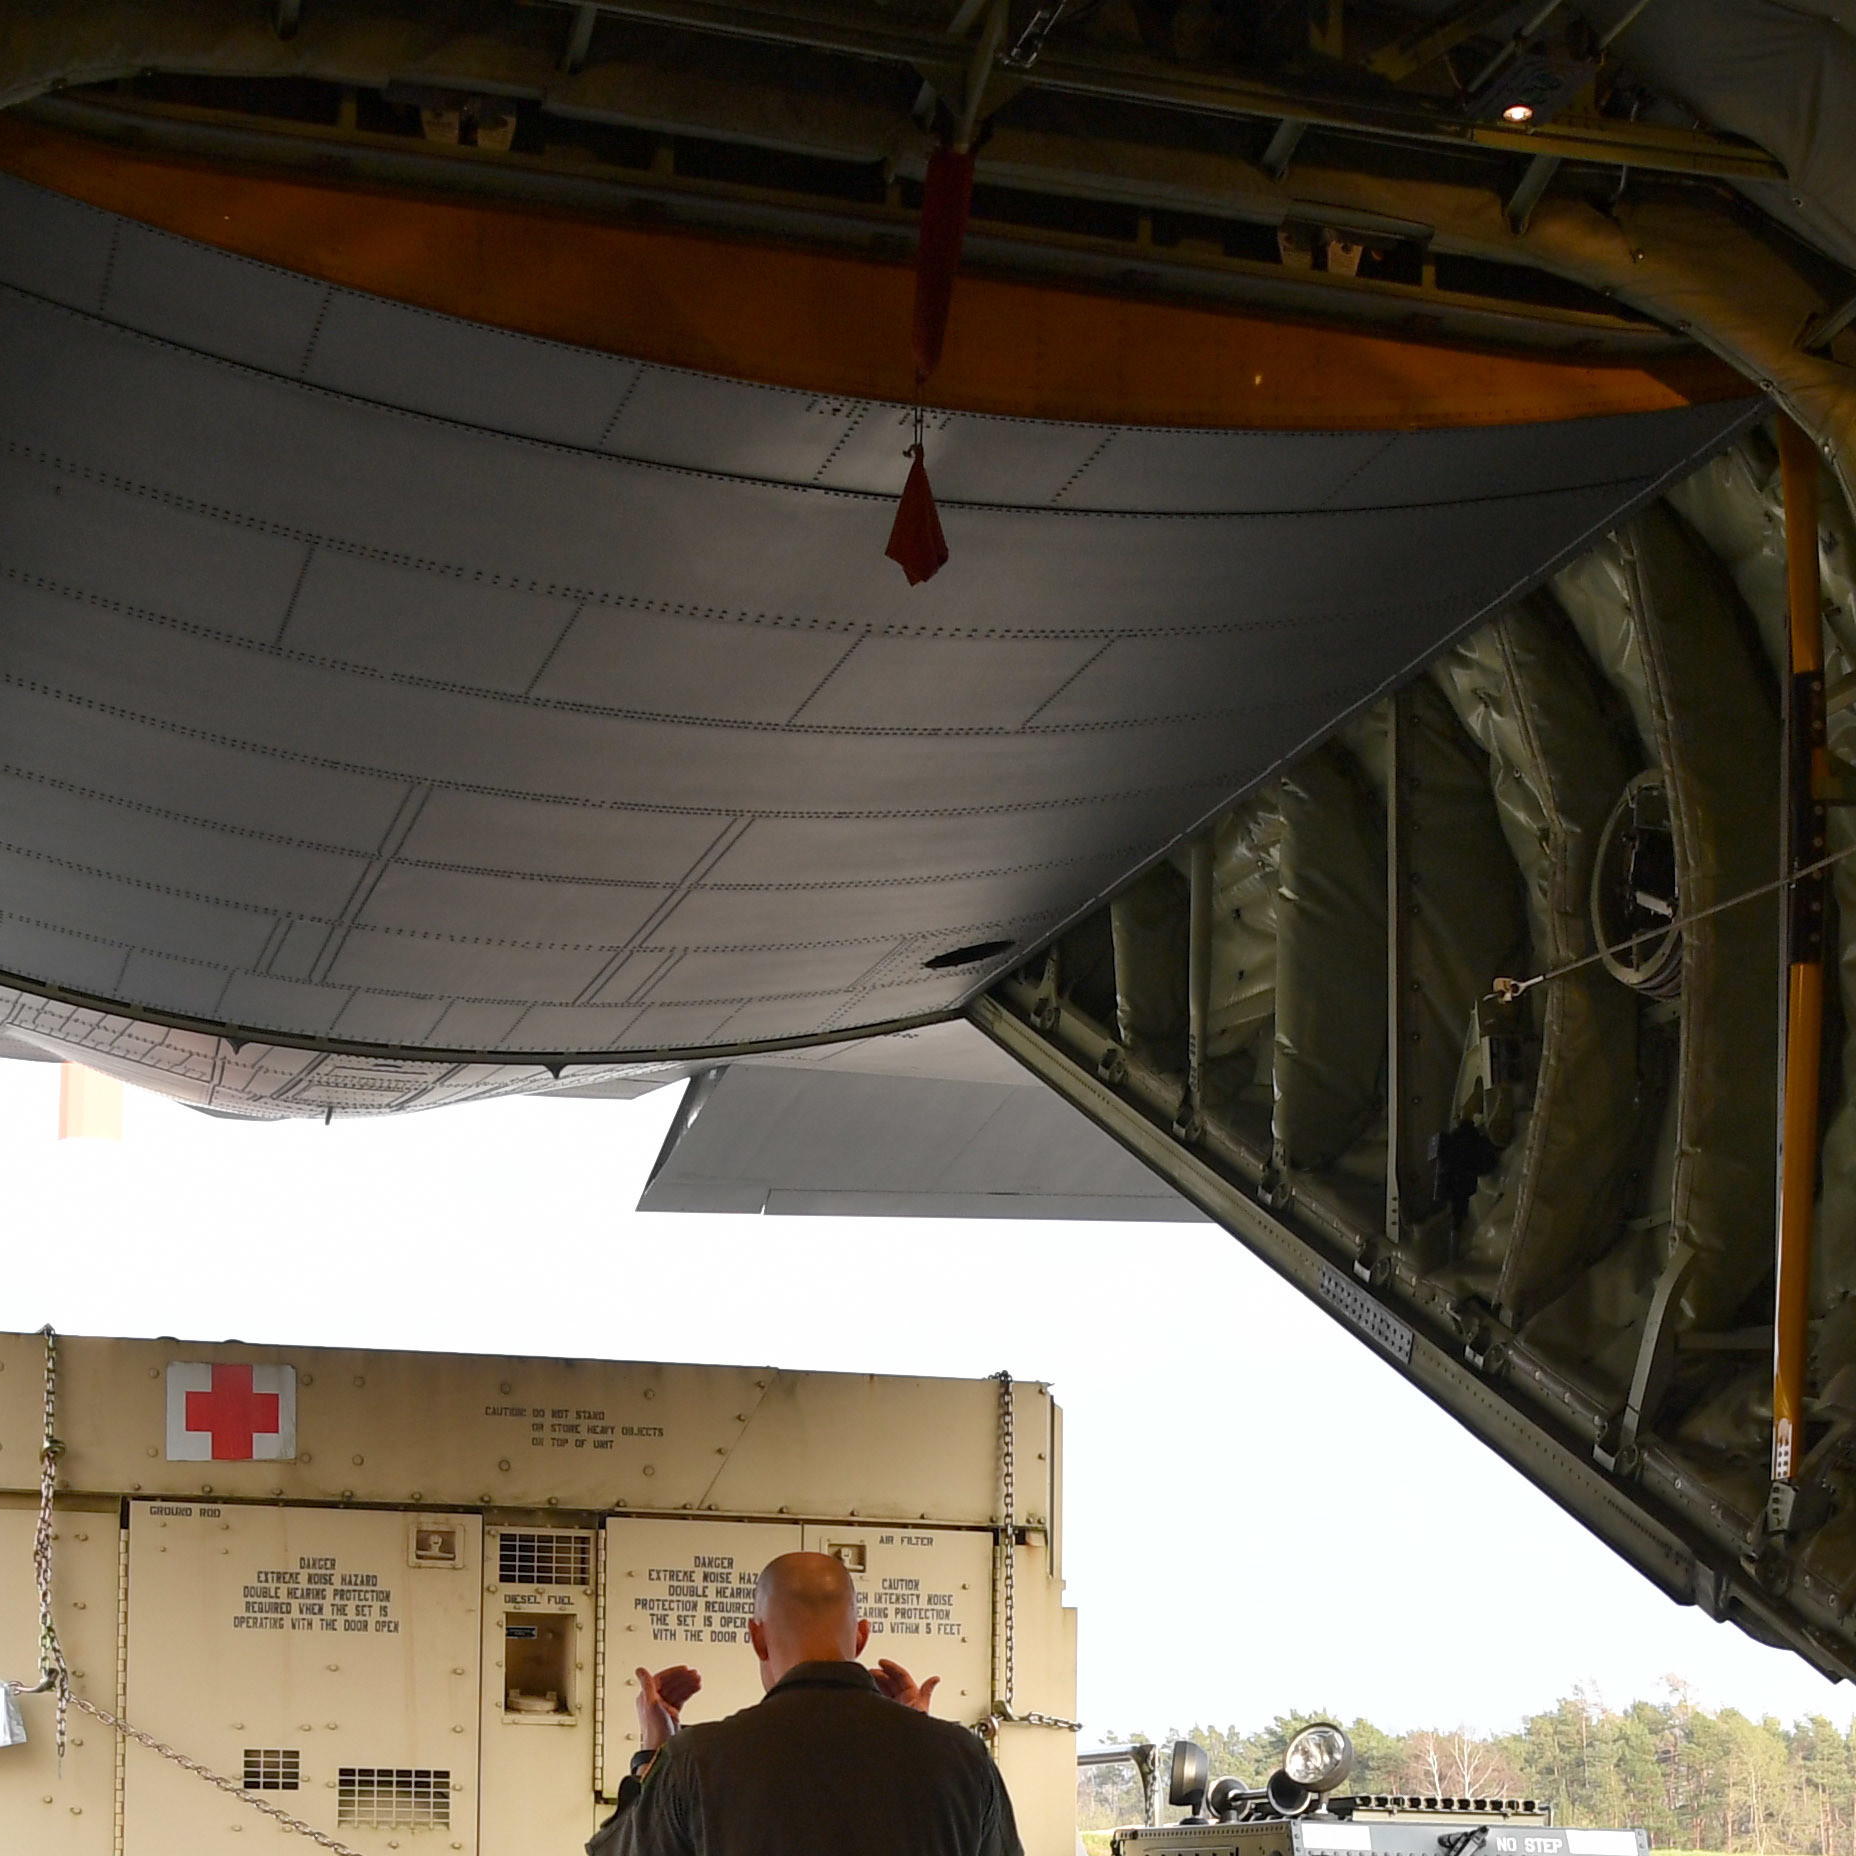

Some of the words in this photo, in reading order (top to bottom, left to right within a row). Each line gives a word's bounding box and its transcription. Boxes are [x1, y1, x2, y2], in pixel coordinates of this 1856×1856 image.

[532, 1408, 545, 1418] DO
[552, 1409, 569, 1419] NOT
[575, 1410, 605, 1421] STAND
[532, 1423, 544, 1432] OR
[550, 1423, 581, 1434] STORE
[587, 1425, 615, 1435] HEAVY
[621, 1426, 664, 1437] OBJECTS
[532, 1437, 544, 1447] ON
[551, 1438, 569, 1447] TOP
[575, 1438, 587, 1448] OF
[593, 1439, 614, 1449] UNIT
[149, 1506, 193, 1517] GROUND
[199, 1507, 221, 1518] ROD
[879, 1535, 894, 1545] AIR
[901, 1536, 934, 1546] FILTER
[299, 1557, 336, 1570] DANGER
[694, 1556, 734, 1570] DANGER
[257, 1571, 300, 1585] EXTREME
[307, 1572, 335, 1586] NOISE
[340, 1574, 378, 1587] HAZARD
[648, 1569, 695, 1583] EXTREME
[702, 1571, 732, 1584] NOISE
[739, 1572, 759, 1585] HAZ
[882, 1578, 920, 1591] CAUTION
[243, 1585, 281, 1599] DOUBLE
[287, 1586, 326, 1601] HEARING
[333, 1588, 391, 1602] PROTECTION
[668, 1584, 709, 1599] DOUBLE
[504, 1594, 541, 1605] DIESEL
[547, 1595, 575, 1606] FUEL
[634, 1598, 698, 1613] PROTECTION
[705, 1600, 756, 1614] REQUIRED
[856, 1592, 869, 1604] GH
[874, 1592, 921, 1606] INTENSITY
[927, 1594, 953, 1607] NOISE
[245, 1601, 292, 1615] REQUIRED
[298, 1602, 324, 1616] WHEN
[330, 1603, 348, 1616] THE
[355, 1604, 373, 1617] SET
[379, 1605, 388, 1618] IS
[857, 1606, 889, 1619] EARING
[894, 1607, 951, 1620] PROTECTION
[233, 1616, 284, 1630] OPERATING
[291, 1618, 313, 1631] WITH
[320, 1619, 337, 1632] THE
[344, 1619, 368, 1633] DOOR
[375, 1620, 400, 1633] OPEN
[649, 1613, 669, 1626] THE
[677, 1614, 695, 1627] SET
[703, 1615, 713, 1628] IS
[652, 1628, 676, 1641] WITH
[684, 1629, 704, 1642] THE
[710, 1630, 737, 1643] DOOR
[890, 1621, 920, 1634] WITHIN
[925, 1622, 932, 1635] 5
[938, 1623, 962, 1636] FEET
[1496, 1836, 1517, 1852] NO
[1524, 1837, 1563, 1854] STEP
